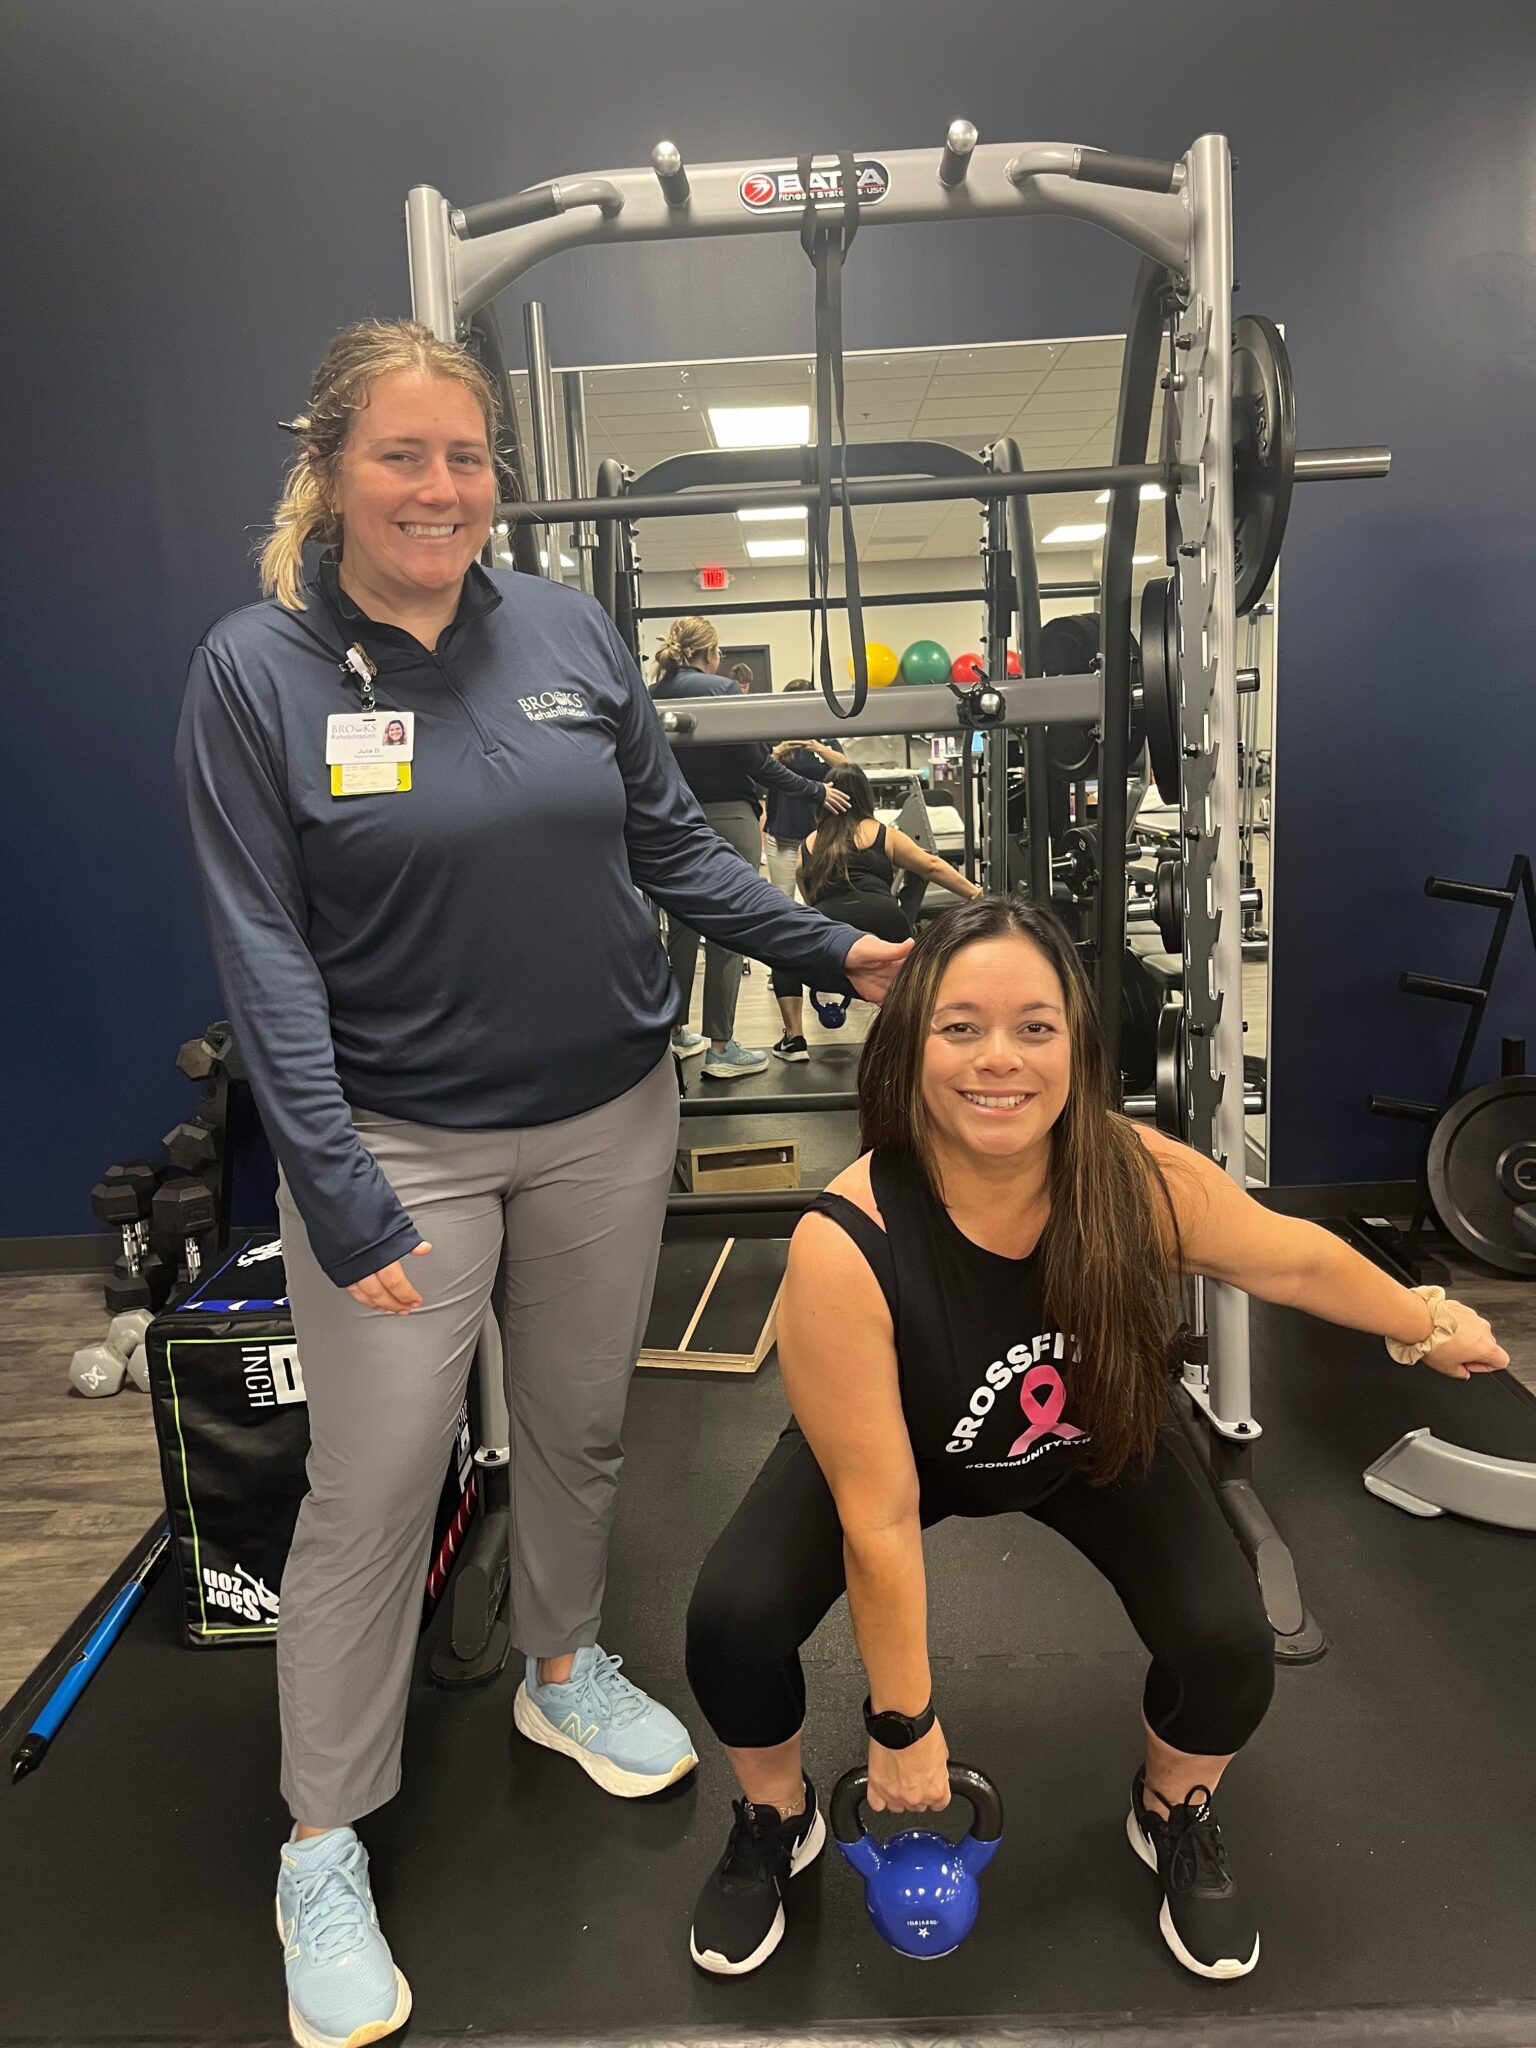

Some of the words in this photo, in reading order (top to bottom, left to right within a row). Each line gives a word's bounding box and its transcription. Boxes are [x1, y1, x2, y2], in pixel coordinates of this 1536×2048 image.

[777, 168, 886, 193] BATA
[517, 691, 583, 712] BROOKS
[241, 1346, 276, 1408] INCH
[945, 1332, 1082, 1453] CROSSFI
